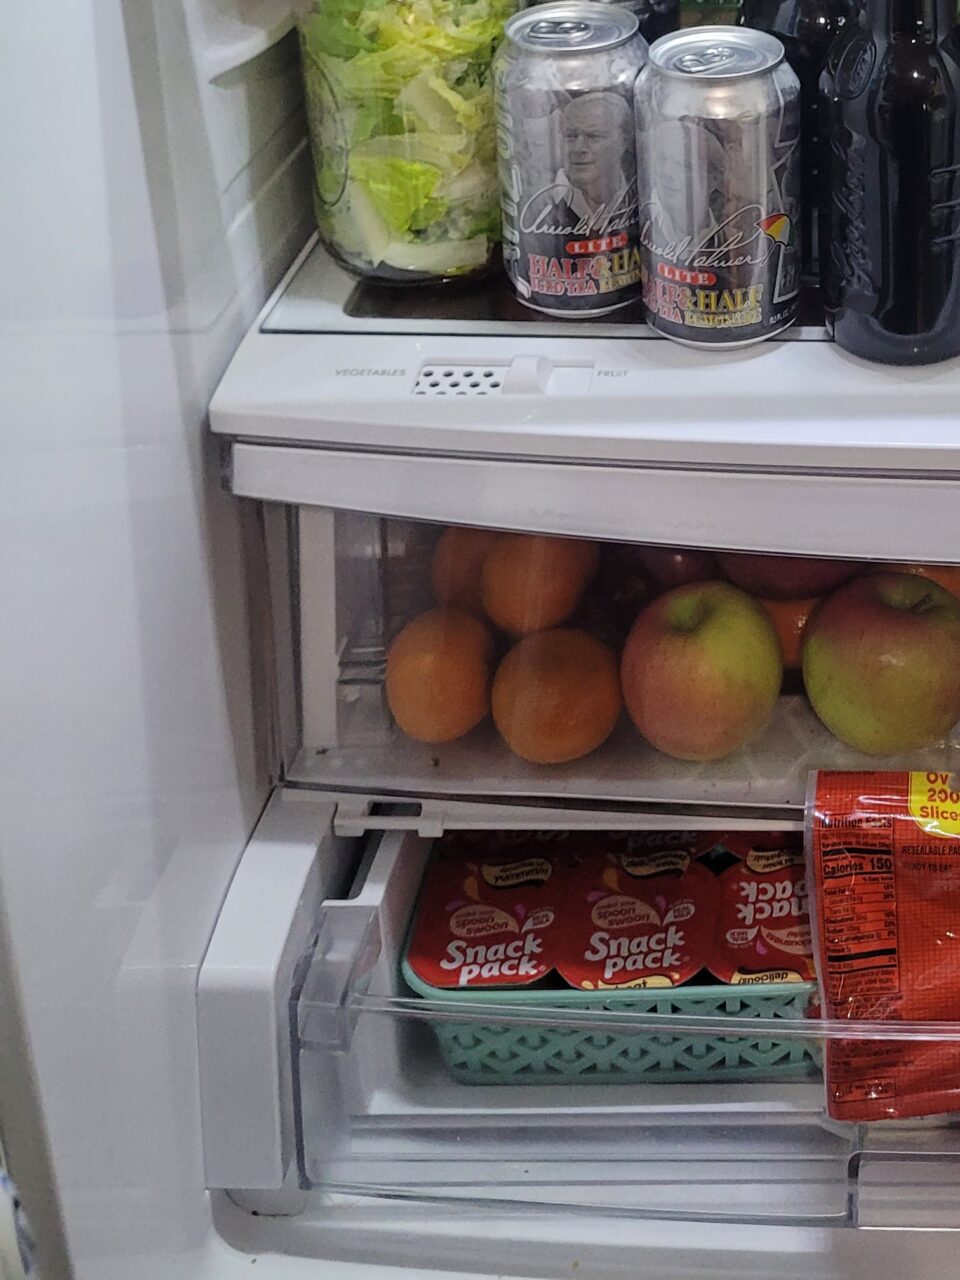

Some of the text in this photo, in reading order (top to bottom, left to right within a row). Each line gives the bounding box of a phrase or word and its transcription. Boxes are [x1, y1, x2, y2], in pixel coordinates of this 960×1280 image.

[572, 234, 622, 254] LITE
[663, 268, 709, 285] LITE
[566, 277, 598, 297] TEA
[335, 368, 628, 377] VEGETABLES FRUIT
[927, 787, 960, 804] 200
[902, 845, 946, 856] RESEALABLE
[823, 856, 893, 875] Calories 150
[597, 908, 636, 920] spoon
[608, 914, 650, 927] swoon
[736, 900, 807, 926] nack
[439, 933, 544, 970] Snack
[584, 925, 686, 961] Snack
[459, 956, 538, 987] pack
[604, 948, 682, 979] pack
